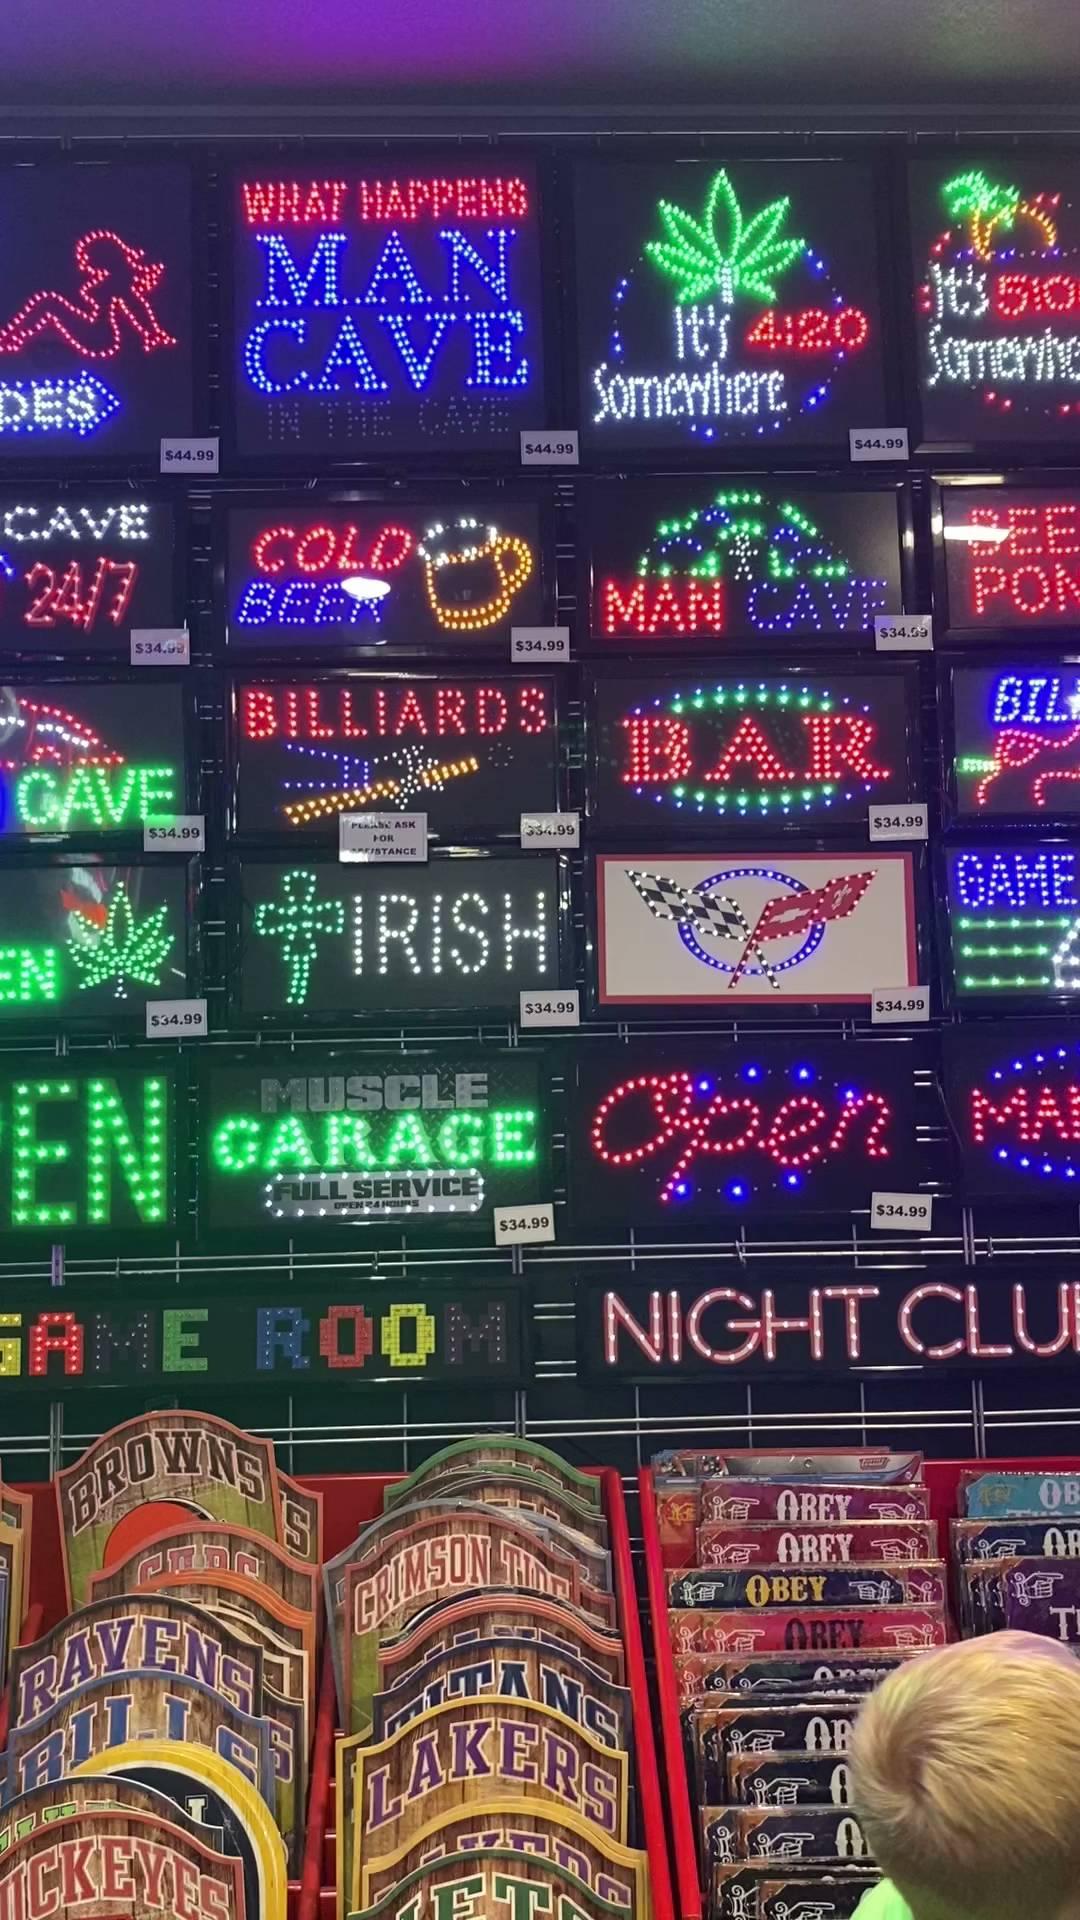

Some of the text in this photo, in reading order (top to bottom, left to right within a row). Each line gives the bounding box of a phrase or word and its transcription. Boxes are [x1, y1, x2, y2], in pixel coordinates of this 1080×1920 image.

[243, 177, 529, 222] WHAT HAPPENS
[256, 229, 517, 307] MAN
[244, 310, 530, 394] CAVE
[591, 360, 788, 422] Somewhere
[164, 448, 215, 463] $44.99
[525, 442, 574, 456] $44.99
[854, 437, 904, 451] $44.99
[3, 503, 150, 541] CAVE
[254, 525, 412, 572] COLD
[24, 556, 138, 633] 24/7
[604, 580, 725, 634] MAN
[515, 639, 565, 653] $34.99
[246, 687, 548, 739] BILLIARDS
[621, 715, 893, 783] BAR
[17, 767, 175, 827] CAVE
[148, 827, 201, 840] $34.99
[372, 833, 395, 843] FOR
[394, 820, 417, 829] ASK
[873, 815, 923, 829] $34.99
[957, 854, 1079, 907] GAME
[351, 890, 549, 976] IRISH
[150, 1012, 203, 1027] $34.99
[524, 1001, 576, 1016] $34.99
[875, 998, 926, 1013] $34.99
[260, 1072, 489, 1113] MUSCLE
[12, 1075, 168, 1226] EN
[211, 1109, 538, 1171] GARAGE
[273, 1176, 482, 1201] FULL SERVICE
[875, 1203, 928, 1219] $34.99
[499, 1216, 550, 1232] $34.99
[256, 1302, 507, 1372] ROOM
[603, 1280, 1080, 1366] NIGHT CLU
[68, 1428, 266, 1538] BROWNS
[775, 1489, 853, 1521] OBEY
[777, 1532, 854, 1563] OBEY
[354, 1533, 492, 1636] CRIMSON
[745, 1573, 828, 1607] OBEY
[17, 1613, 255, 1729] RAVENS
[365, 1717, 618, 1835] LAKERS
